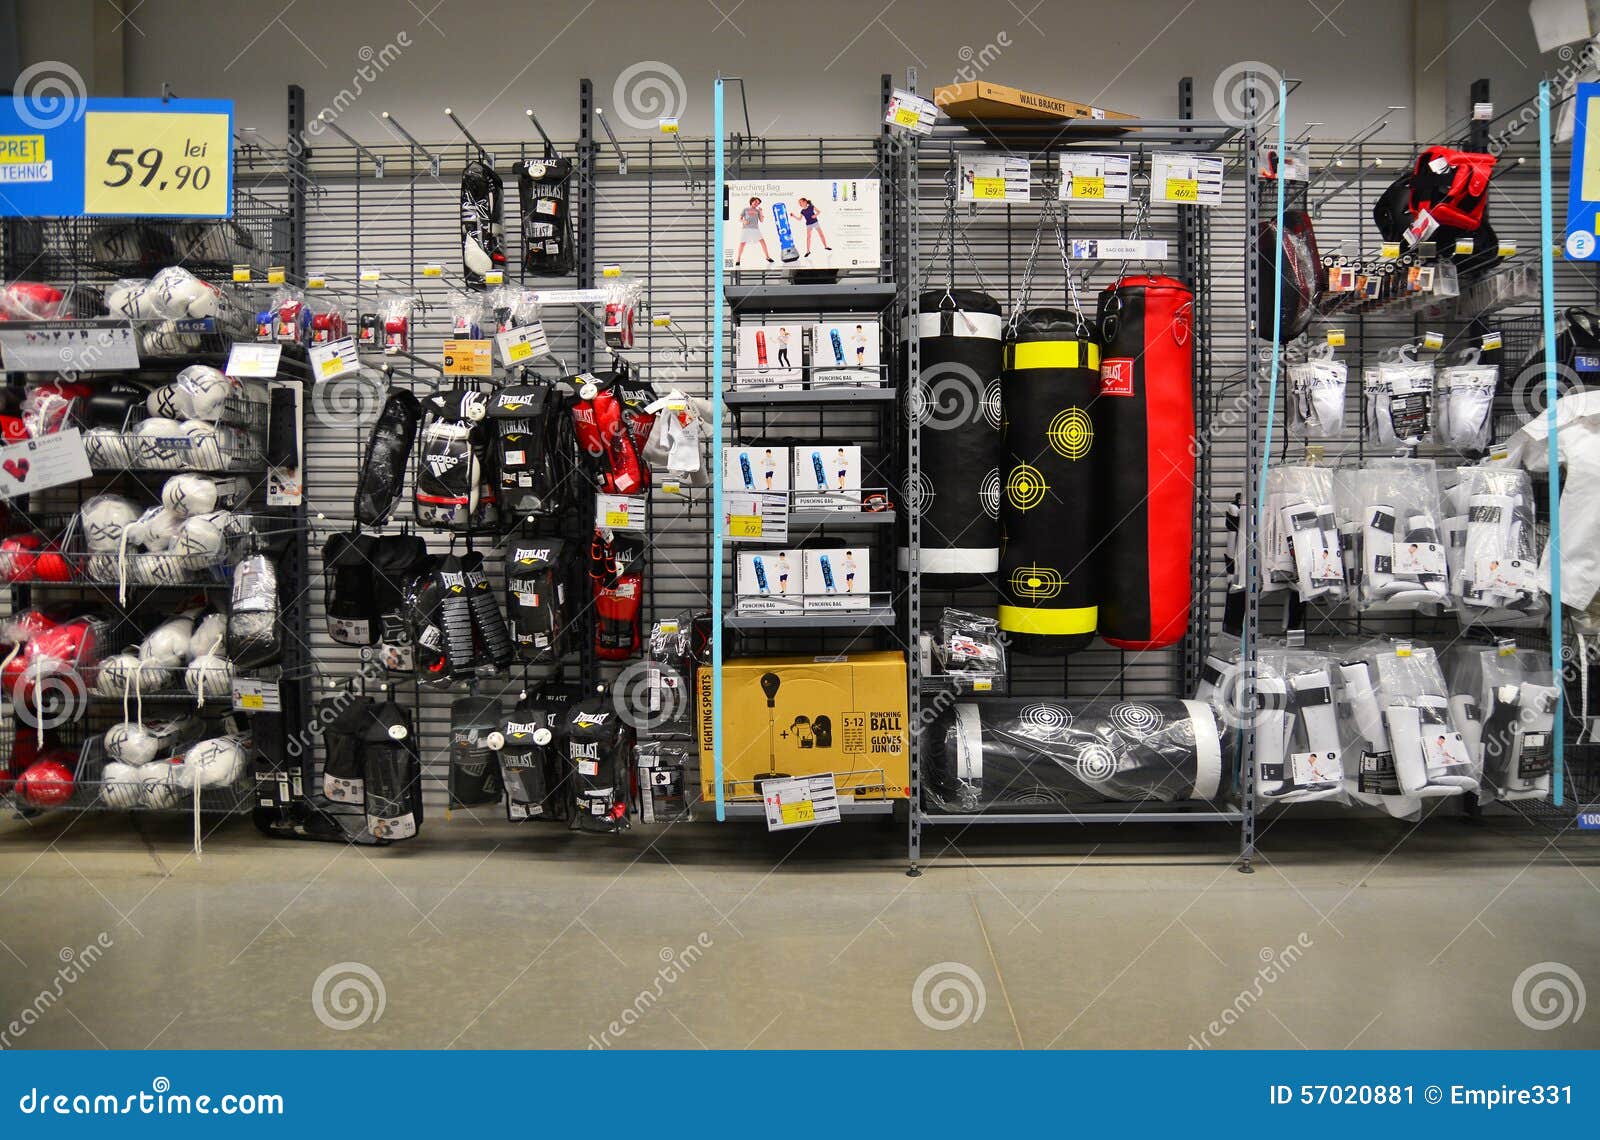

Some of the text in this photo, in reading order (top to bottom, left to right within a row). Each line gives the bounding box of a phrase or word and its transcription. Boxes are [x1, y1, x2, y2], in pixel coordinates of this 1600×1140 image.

[1020, 94, 1065, 112] WALL BRACKET
[184, 138, 208, 157] lei
[2, 164, 48, 180] TEHNIC
[1576, 239, 1585, 250] 2
[191, 322, 207, 330] OZ
[498, 394, 535, 407] EVERLAST
[514, 548, 550, 562] EVERLAST
[571, 711, 610, 726] EVERLAST
[702, 674, 713, 751] FIGHTING SPORTS
[506, 721, 536, 735] EVERLAST
[844, 717, 864, 727] 5-12
[870, 718, 902, 731] BALL
[871, 735, 902, 745] GLOVES
[569, 741, 600, 761] EVERLAST
[871, 745, 902, 753] JUNIOR
